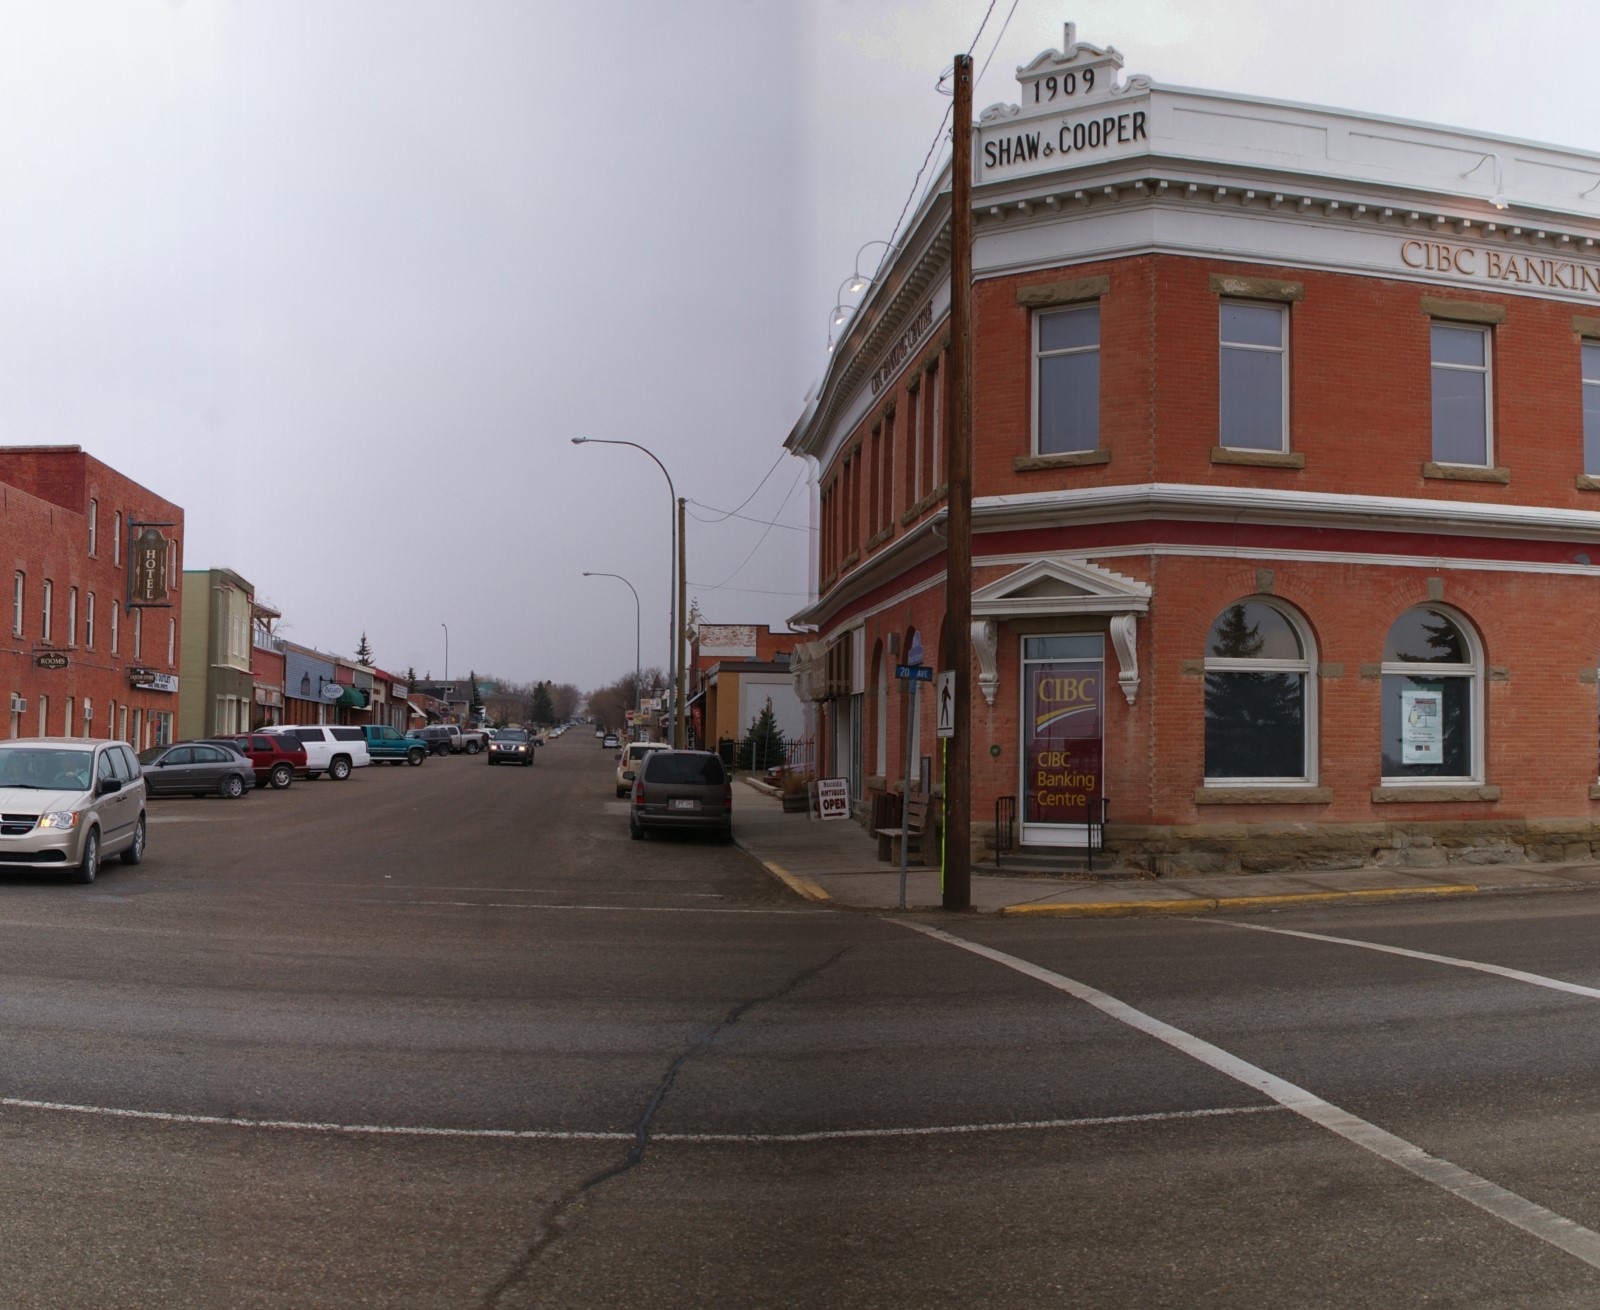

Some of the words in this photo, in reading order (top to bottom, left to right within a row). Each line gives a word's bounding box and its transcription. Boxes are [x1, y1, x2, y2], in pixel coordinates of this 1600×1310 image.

[1034, 68, 1095, 103] 1909
[984, 131, 1041, 168] SHAW
[1043, 142, 1056, 157] &
[1059, 111, 1147, 154] COOPER
[1401, 239, 1475, 276] CIBC
[1486, 251, 1600, 293] BANKIN
[145, 549, 156, 599] HOTEL
[916, 670, 928, 678] AVE
[1038, 678, 1095, 702] CIBC
[1038, 752, 1071, 767] CIBC
[1038, 771, 1095, 791] Banking
[821, 789, 846, 797] ANTIQUES
[1038, 790, 1086, 806] Centre
[823, 798, 846, 810] OPEN
